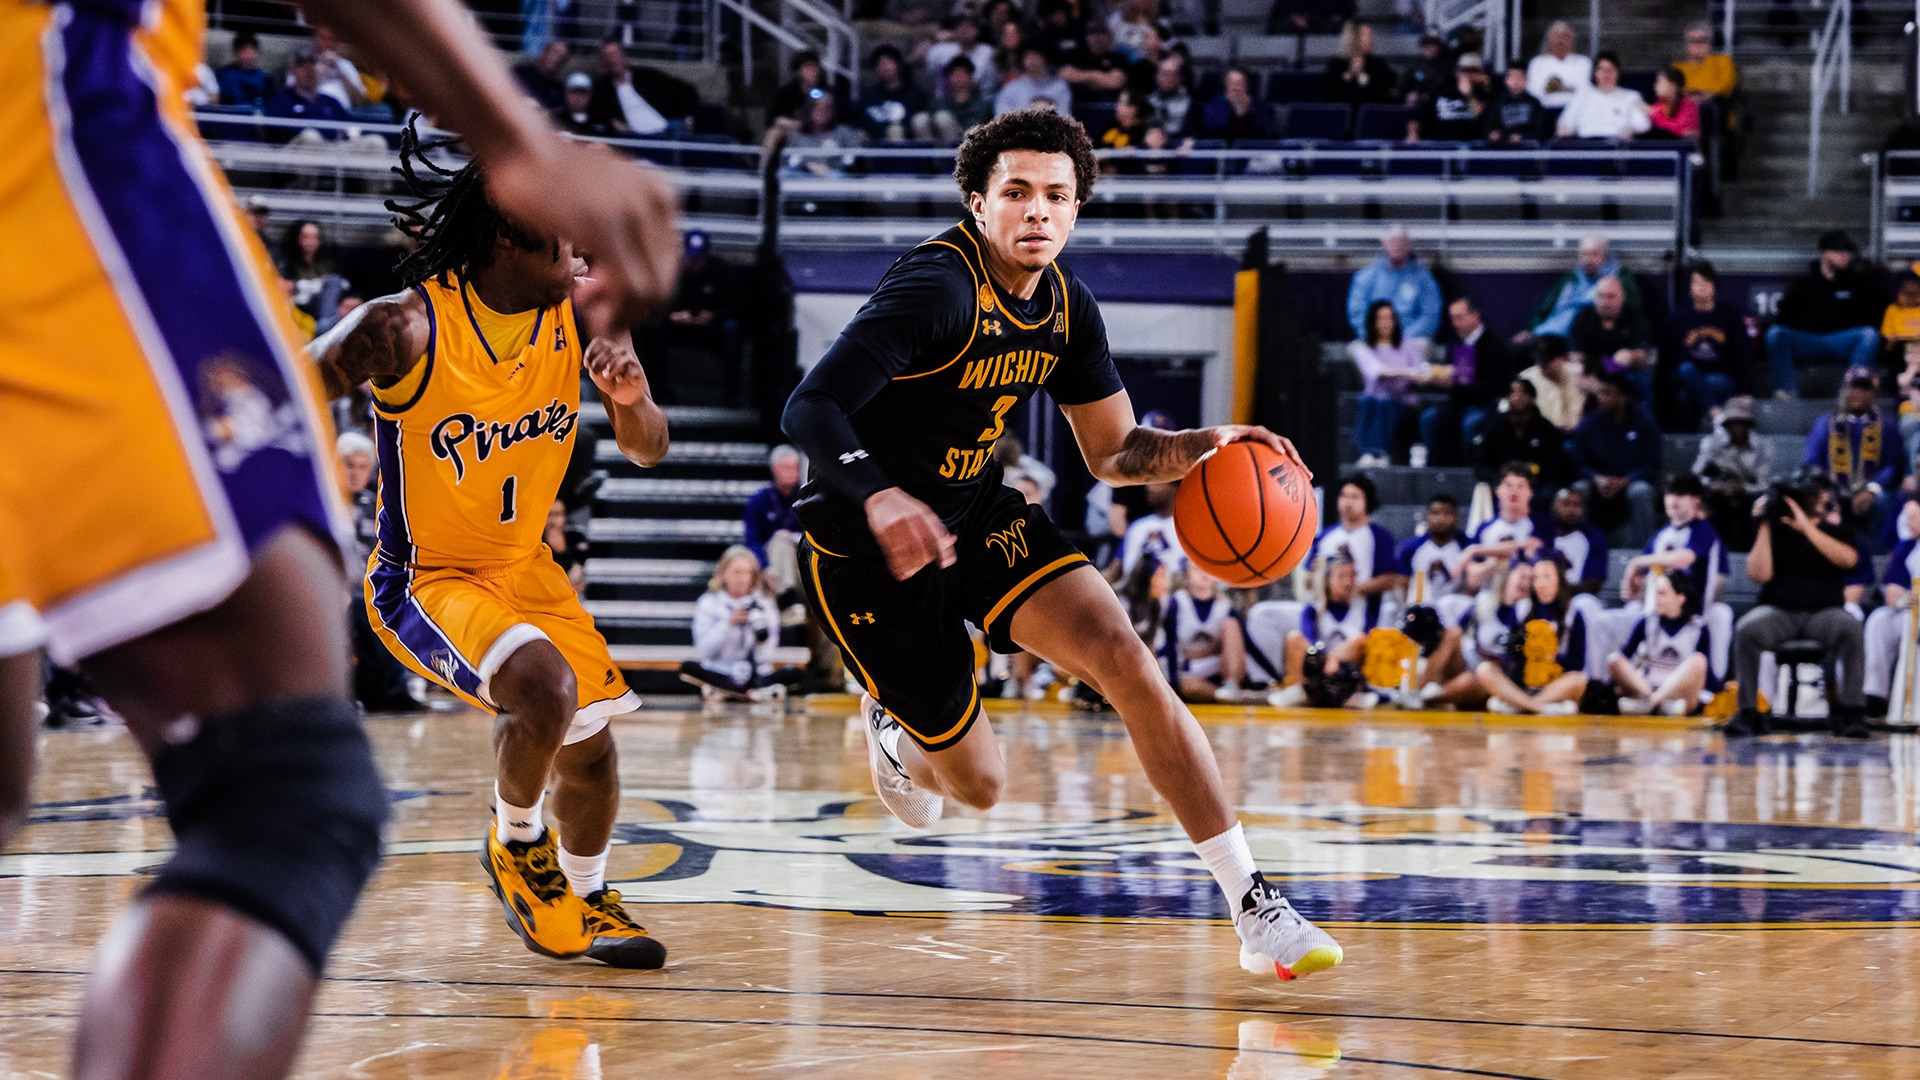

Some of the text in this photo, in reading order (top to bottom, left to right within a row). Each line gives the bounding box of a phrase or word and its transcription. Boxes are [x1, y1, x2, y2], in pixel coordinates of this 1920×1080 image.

[958, 349, 1059, 389] WICHIT
[430, 398, 579, 486] Pirates
[977, 395, 1018, 442] 3
[500, 475, 518, 524] 1
